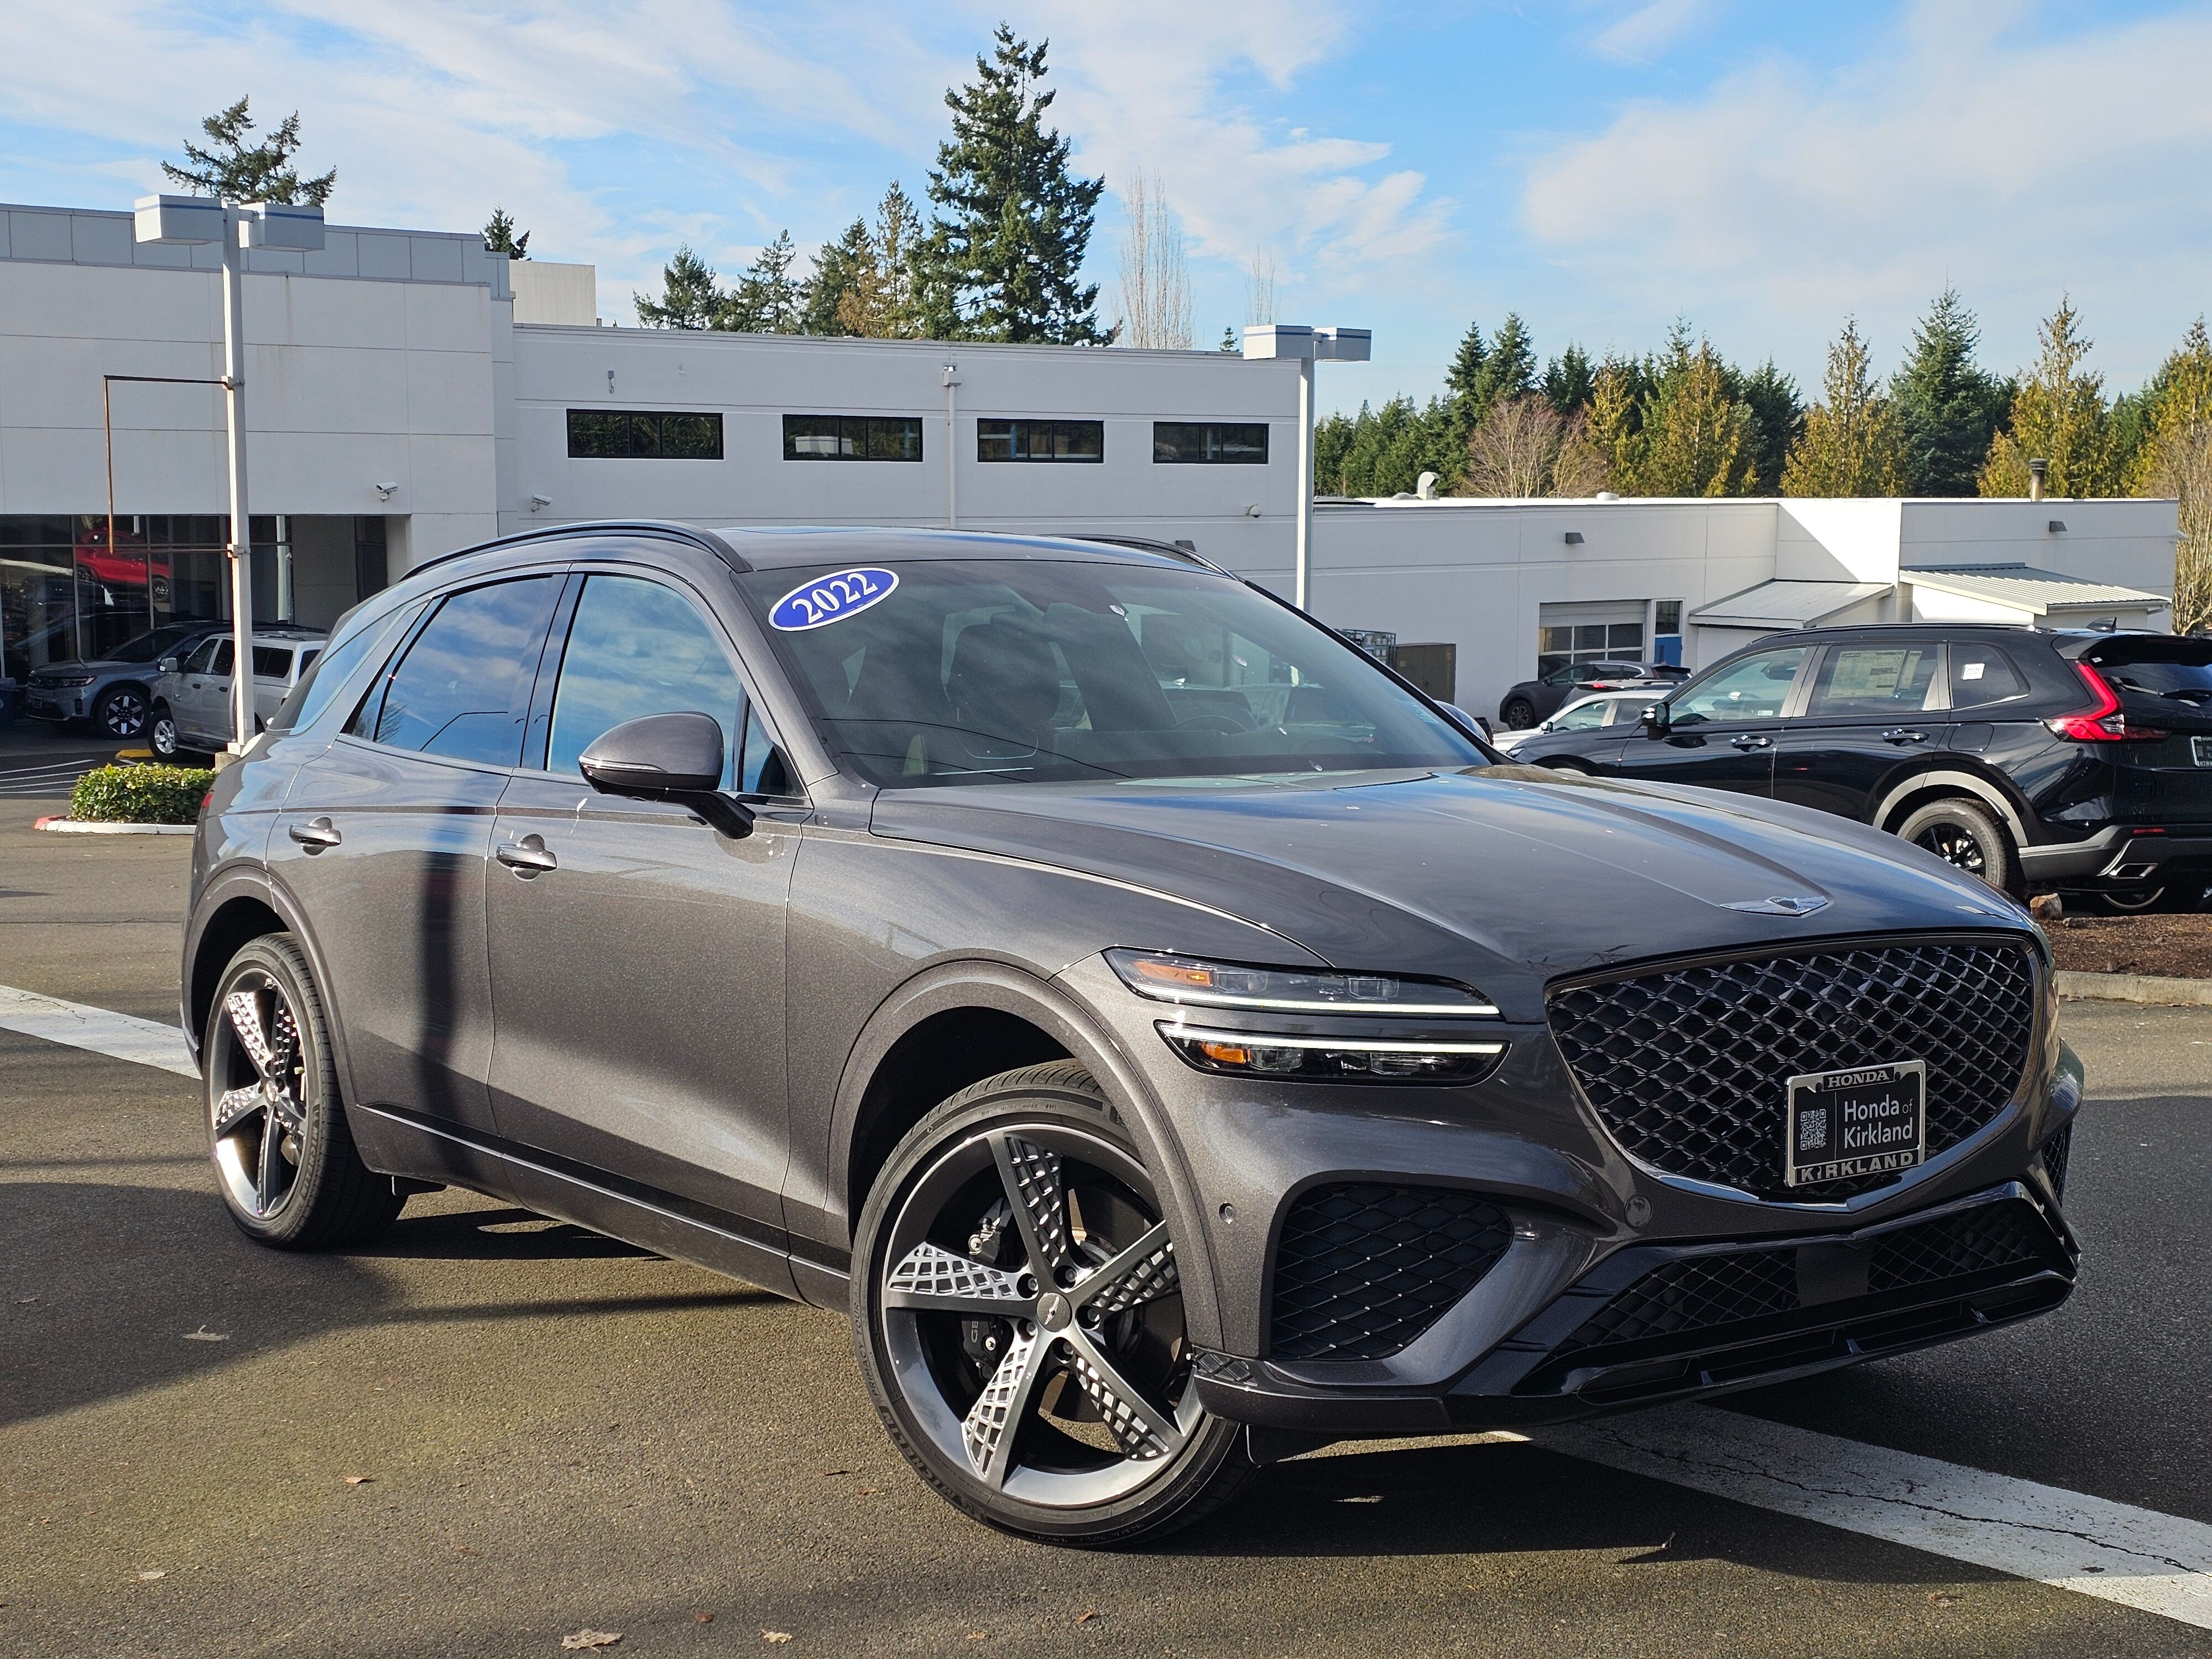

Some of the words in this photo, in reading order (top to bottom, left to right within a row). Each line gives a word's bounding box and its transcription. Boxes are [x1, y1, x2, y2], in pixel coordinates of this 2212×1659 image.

[792, 573, 878, 624] 2022
[1827, 1070, 1890, 1088] HONDA
[1844, 1094, 1900, 1123] Honda
[1902, 1098, 1913, 1114] of
[1844, 1117, 1913, 1149] Kirkland
[1801, 1152, 1913, 1182] KIRKLAND
[854, 1303, 862, 1335] TOUR
[858, 1341, 879, 1396] PRIMACY
[882, 1412, 957, 1499] MICHELIN
